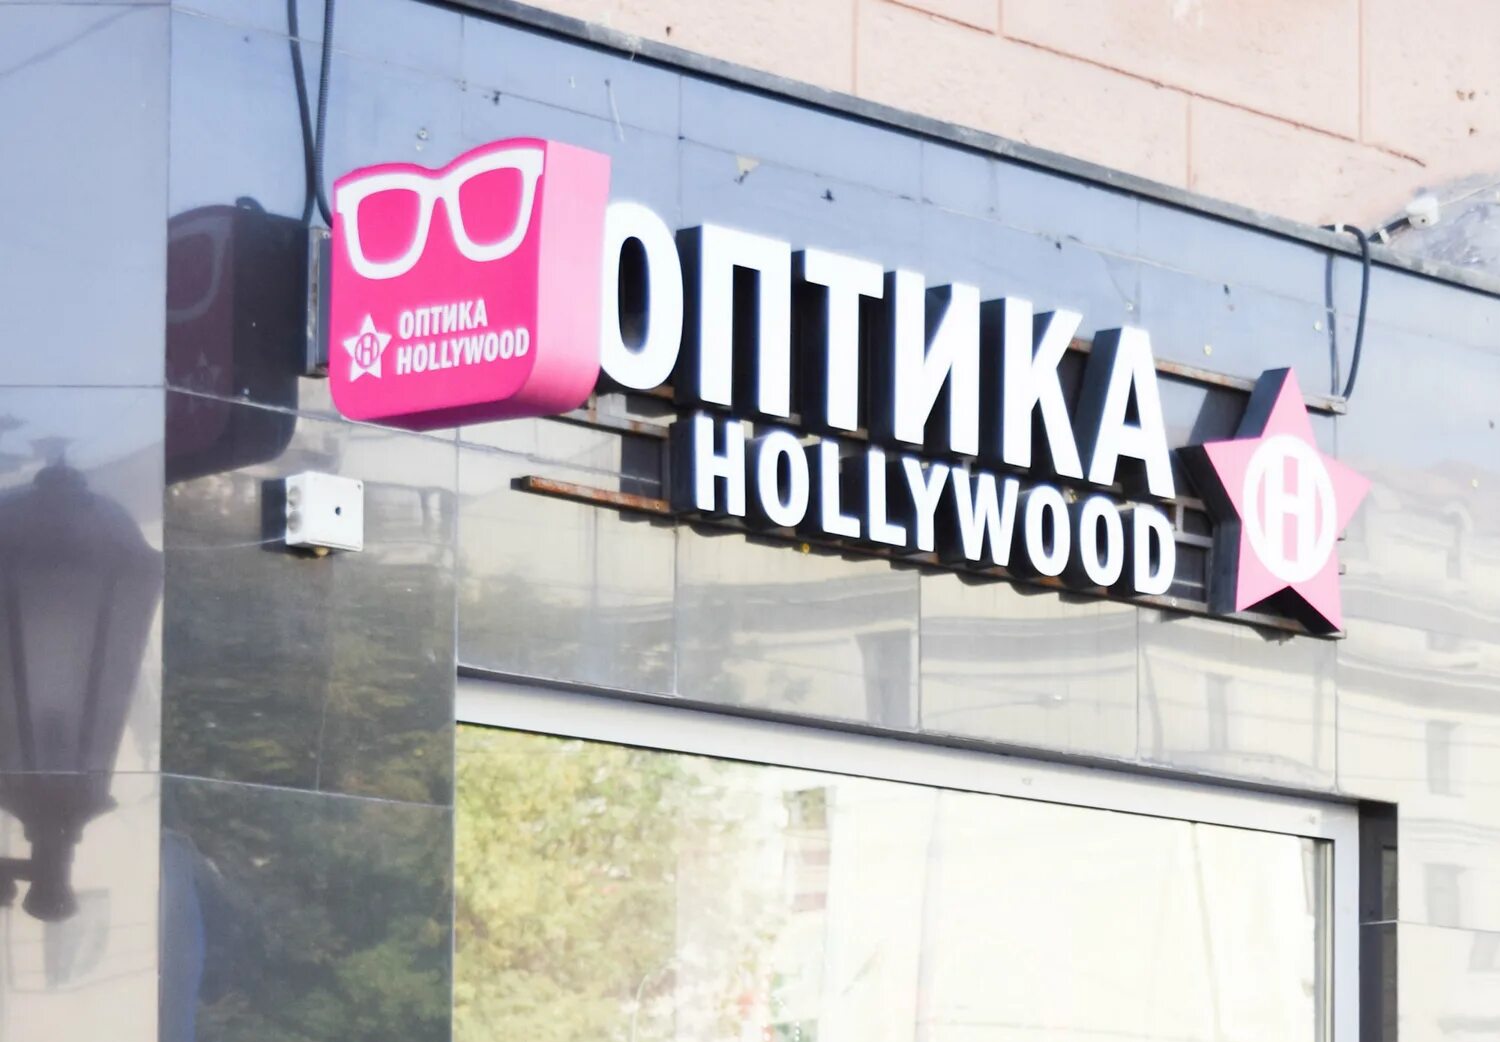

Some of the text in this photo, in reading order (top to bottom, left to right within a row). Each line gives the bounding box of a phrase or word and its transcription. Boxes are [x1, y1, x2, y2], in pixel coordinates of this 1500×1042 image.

[396, 327, 530, 375] HOLLYWOOD
[400, 298, 488, 340] ОПТИКА
[600, 201, 1176, 500] ОПТИКА
[693, 411, 1176, 596] HOLLYWOOD
